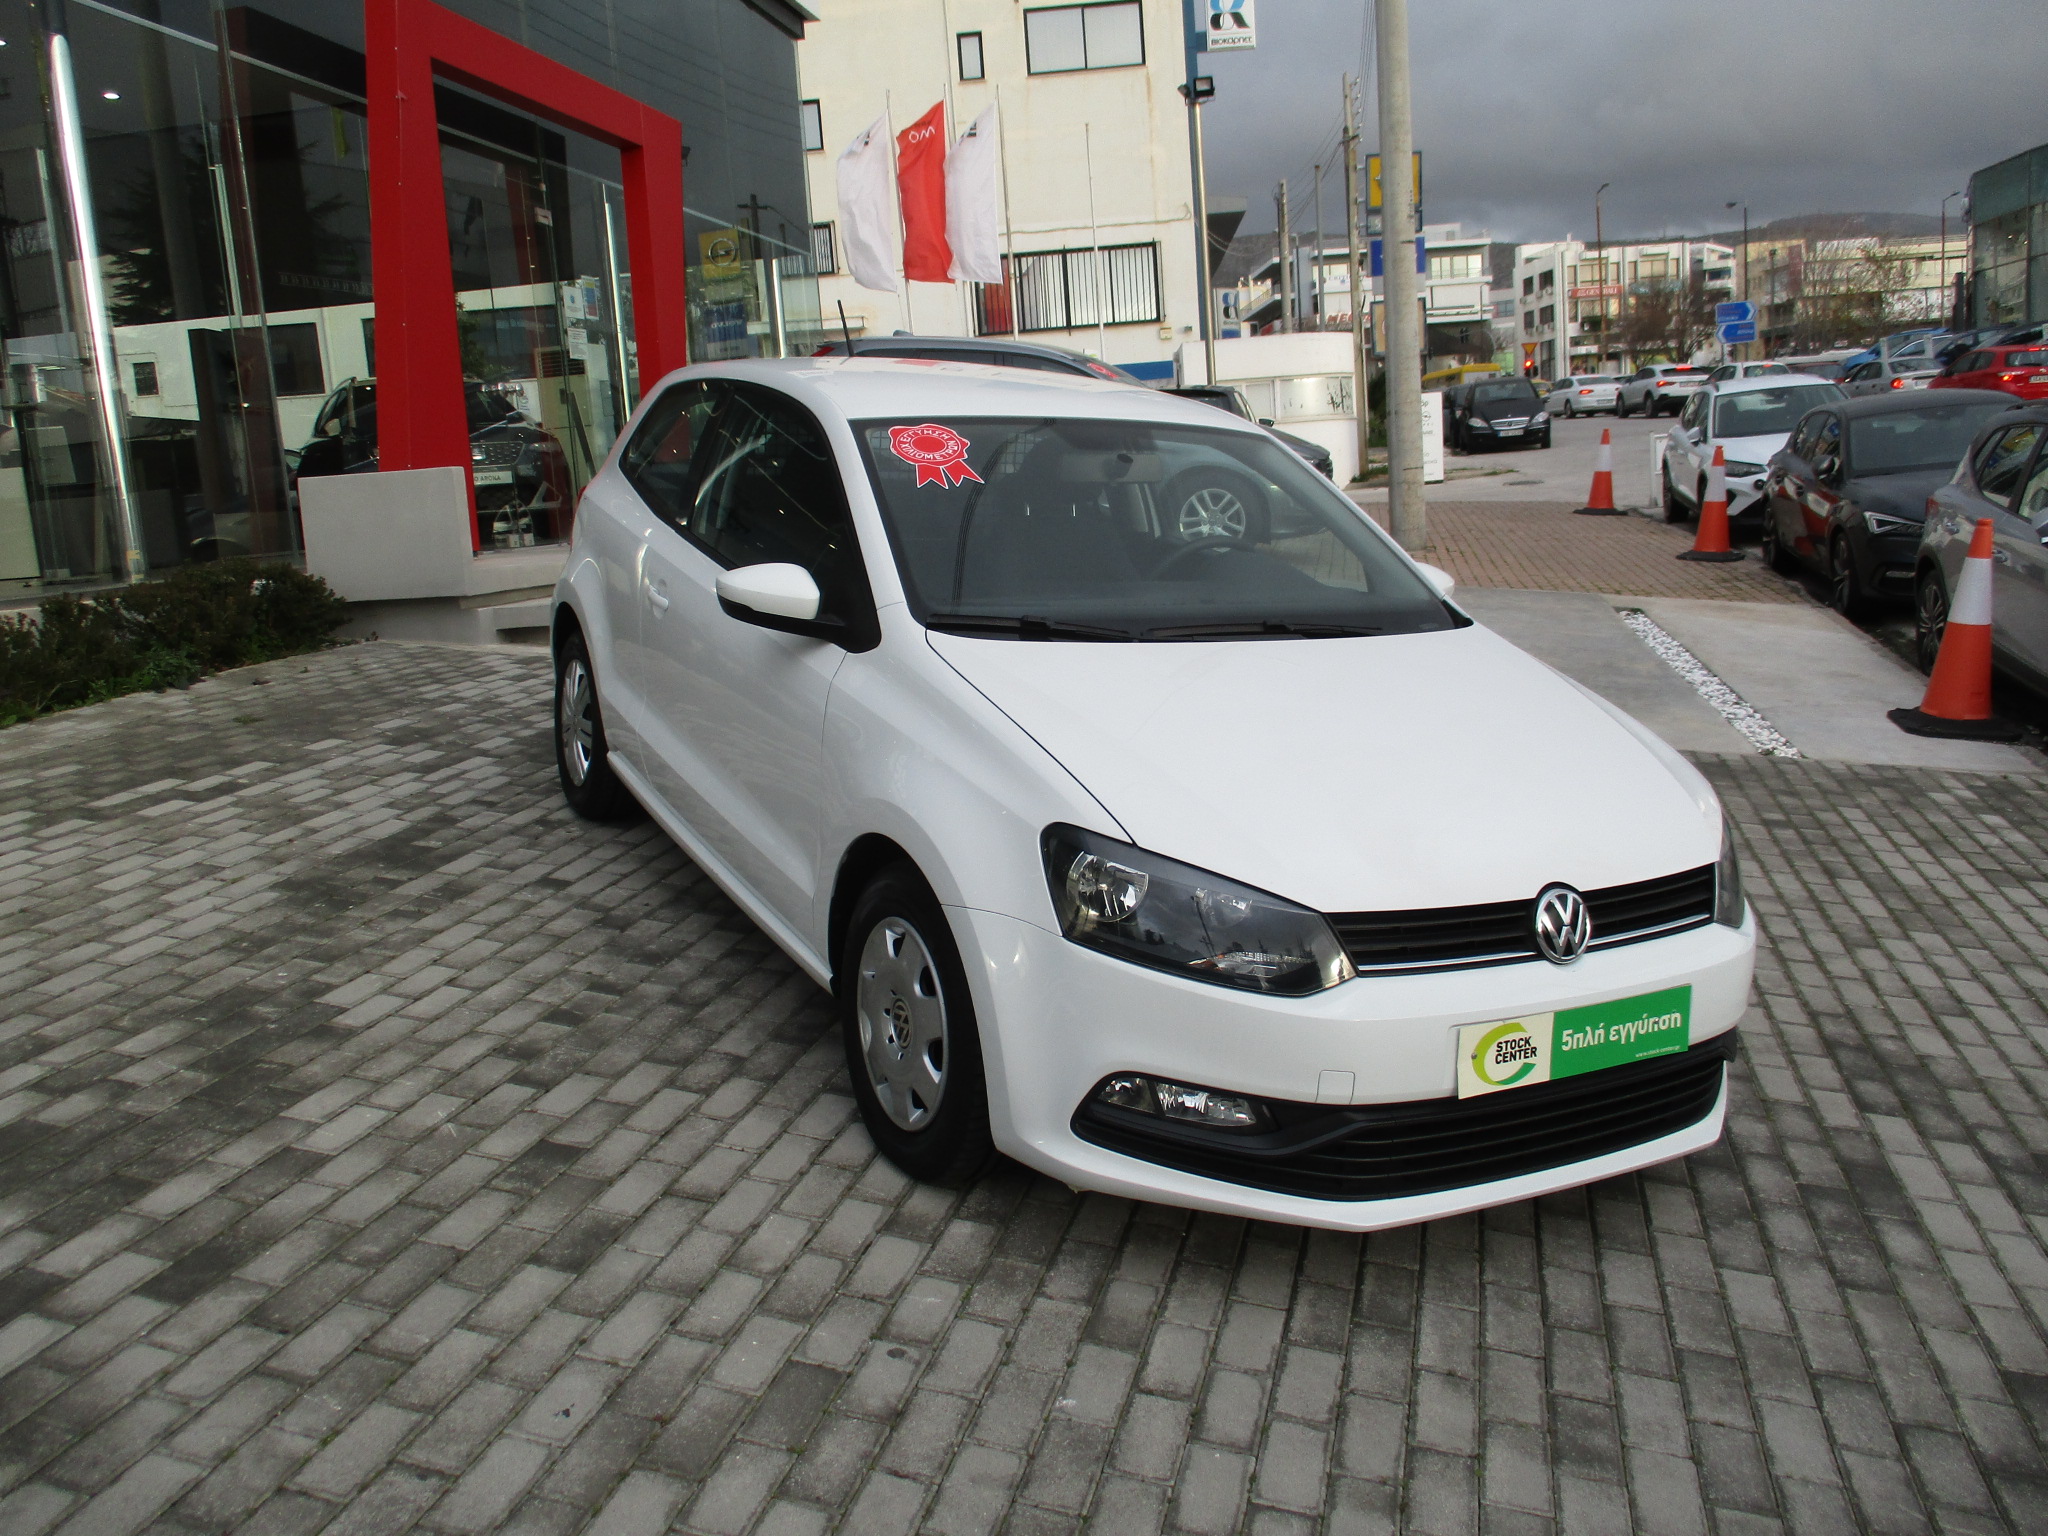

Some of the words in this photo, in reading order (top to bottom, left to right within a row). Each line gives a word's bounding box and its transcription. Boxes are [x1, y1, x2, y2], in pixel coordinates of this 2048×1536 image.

[1561, 1022, 1605, 1051] 5πλή
[1609, 1011, 1682, 1045] εγγύηση
[1495, 1035, 1532, 1053] STOCK
[1495, 1045, 1538, 1065] CENTER
